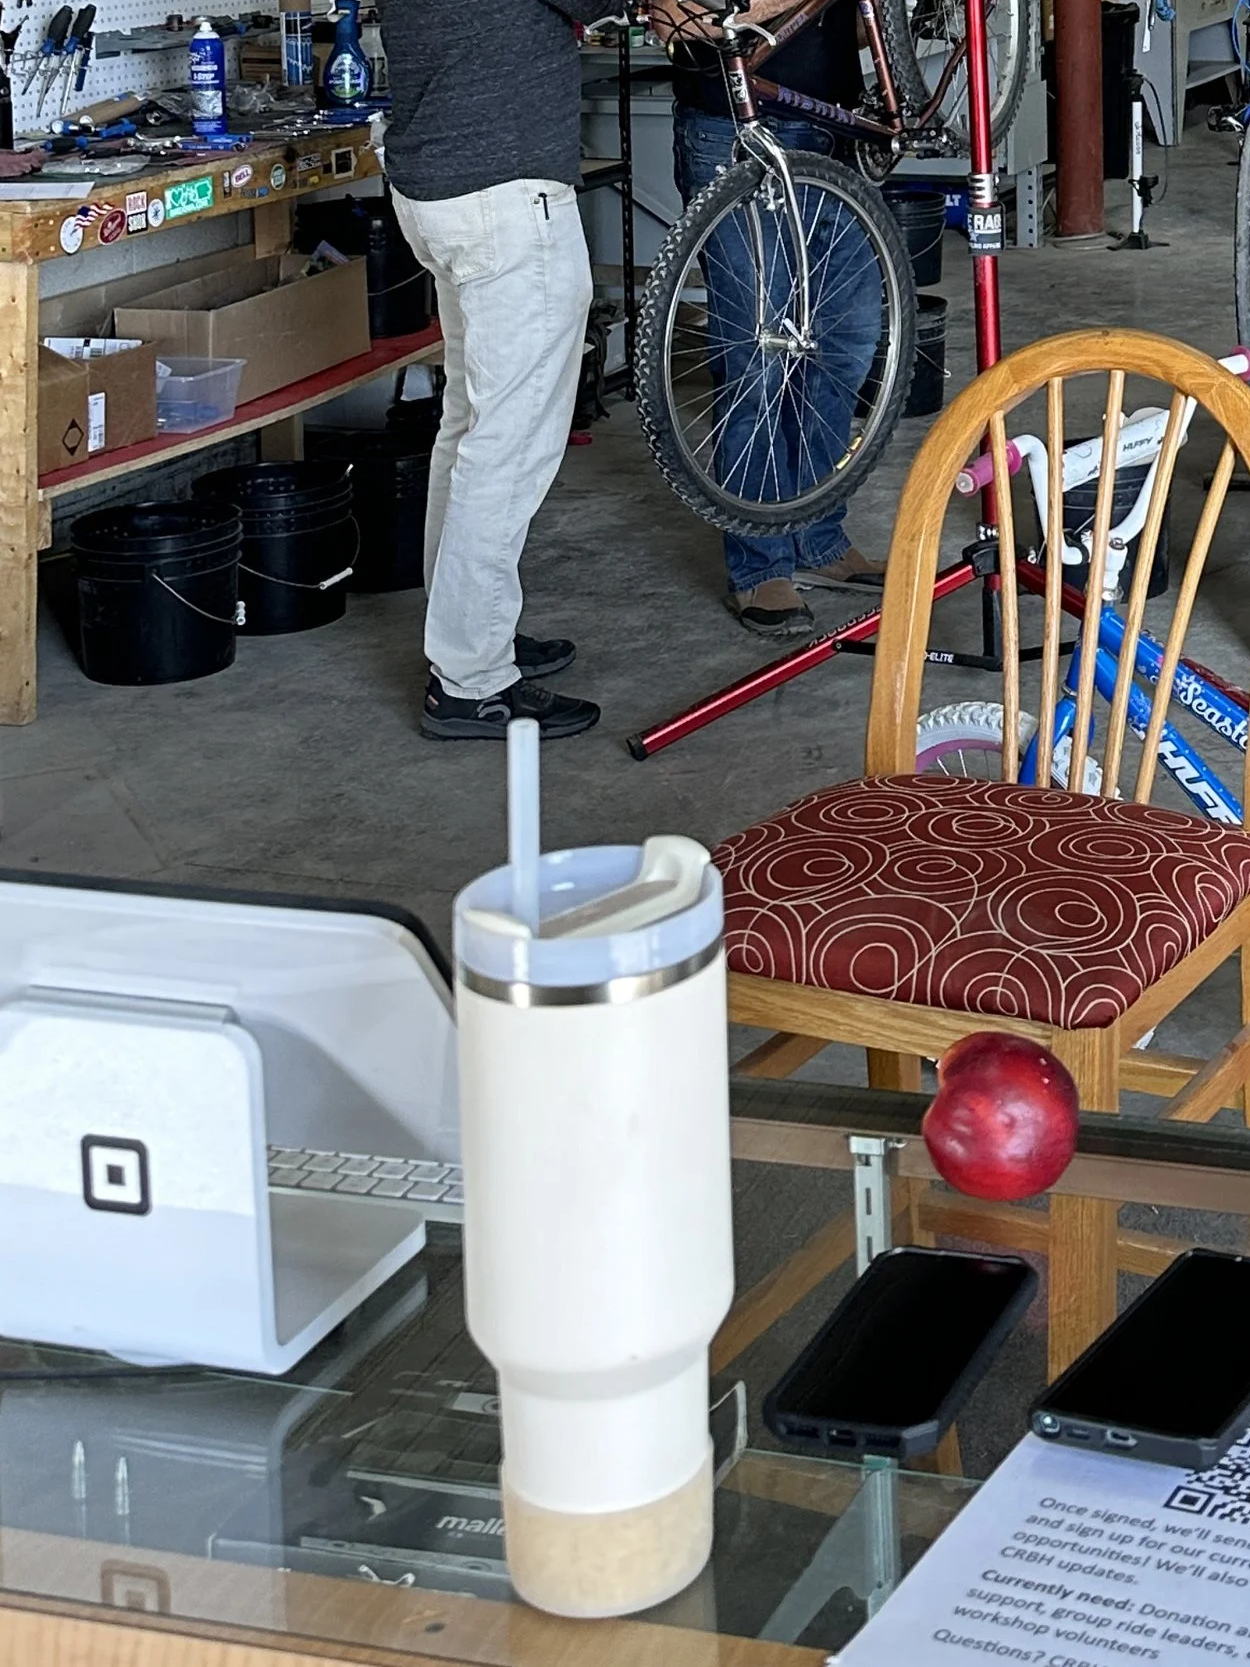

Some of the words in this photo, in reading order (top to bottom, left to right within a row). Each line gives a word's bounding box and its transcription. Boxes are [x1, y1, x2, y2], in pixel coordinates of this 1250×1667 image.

[1024, 1512, 1066, 1531] and
[1067, 1519, 1105, 1540] sign
[1108, 1530, 1135, 1548] up
[1136, 1534, 1168, 1552] for
[1171, 1544, 1205, 1559] our
[1038, 1496, 1088, 1518] Once
[1090, 1508, 1157, 1533] signed,
[1000, 1545, 1057, 1568] CRBH
[1056, 1556, 1140, 1586] updates.
[1010, 1530, 1152, 1568] opportunities!
[1207, 1568, 1249, 1588] also
[965, 1586, 1047, 1616] support,
[1050, 1605, 1113, 1631] group
[1115, 1618, 1157, 1639] ride
[1159, 1627, 1240, 1659] leaders,
[980, 1568, 1077, 1602] Currently
[1076, 1589, 1136, 1613] need:
[1138, 1601, 1233, 1634] Donation
[931, 1627, 1047, 1665] Questions?
[952, 1604, 1051, 1637] workshop
[1054, 1626, 1161, 1661] volunteers
